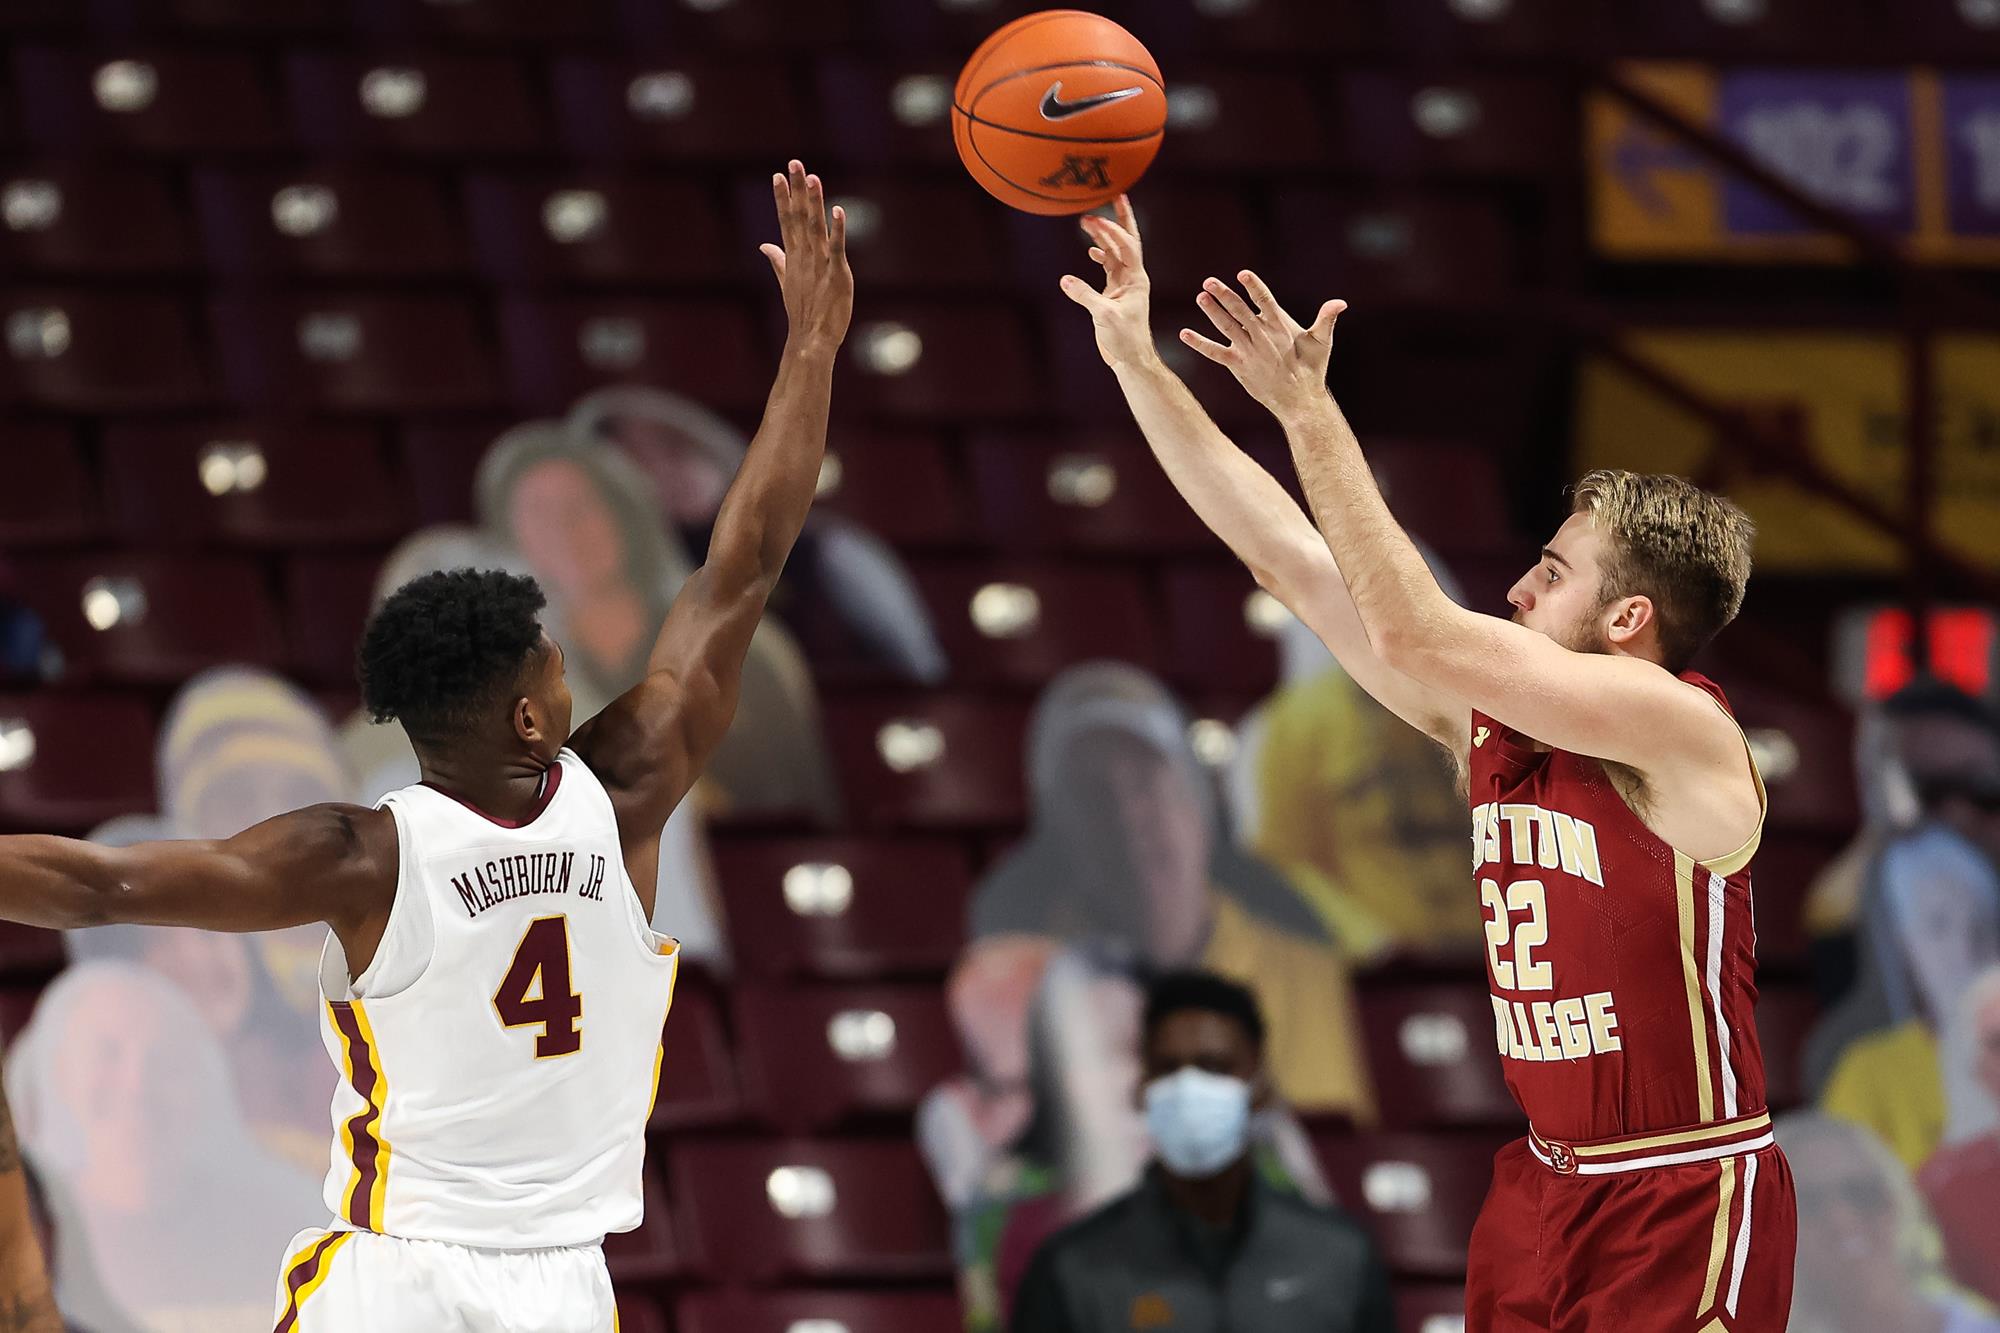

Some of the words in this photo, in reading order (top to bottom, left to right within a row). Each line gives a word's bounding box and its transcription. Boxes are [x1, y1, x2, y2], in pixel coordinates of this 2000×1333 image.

[451, 852, 574, 918] MASHBURN
[579, 854, 606, 901] JR.
[1472, 801, 1604, 888] OSTON
[1481, 878, 1553, 991] 22
[491, 913, 583, 1060] 4
[1490, 991, 1622, 1062] OLLEGE
